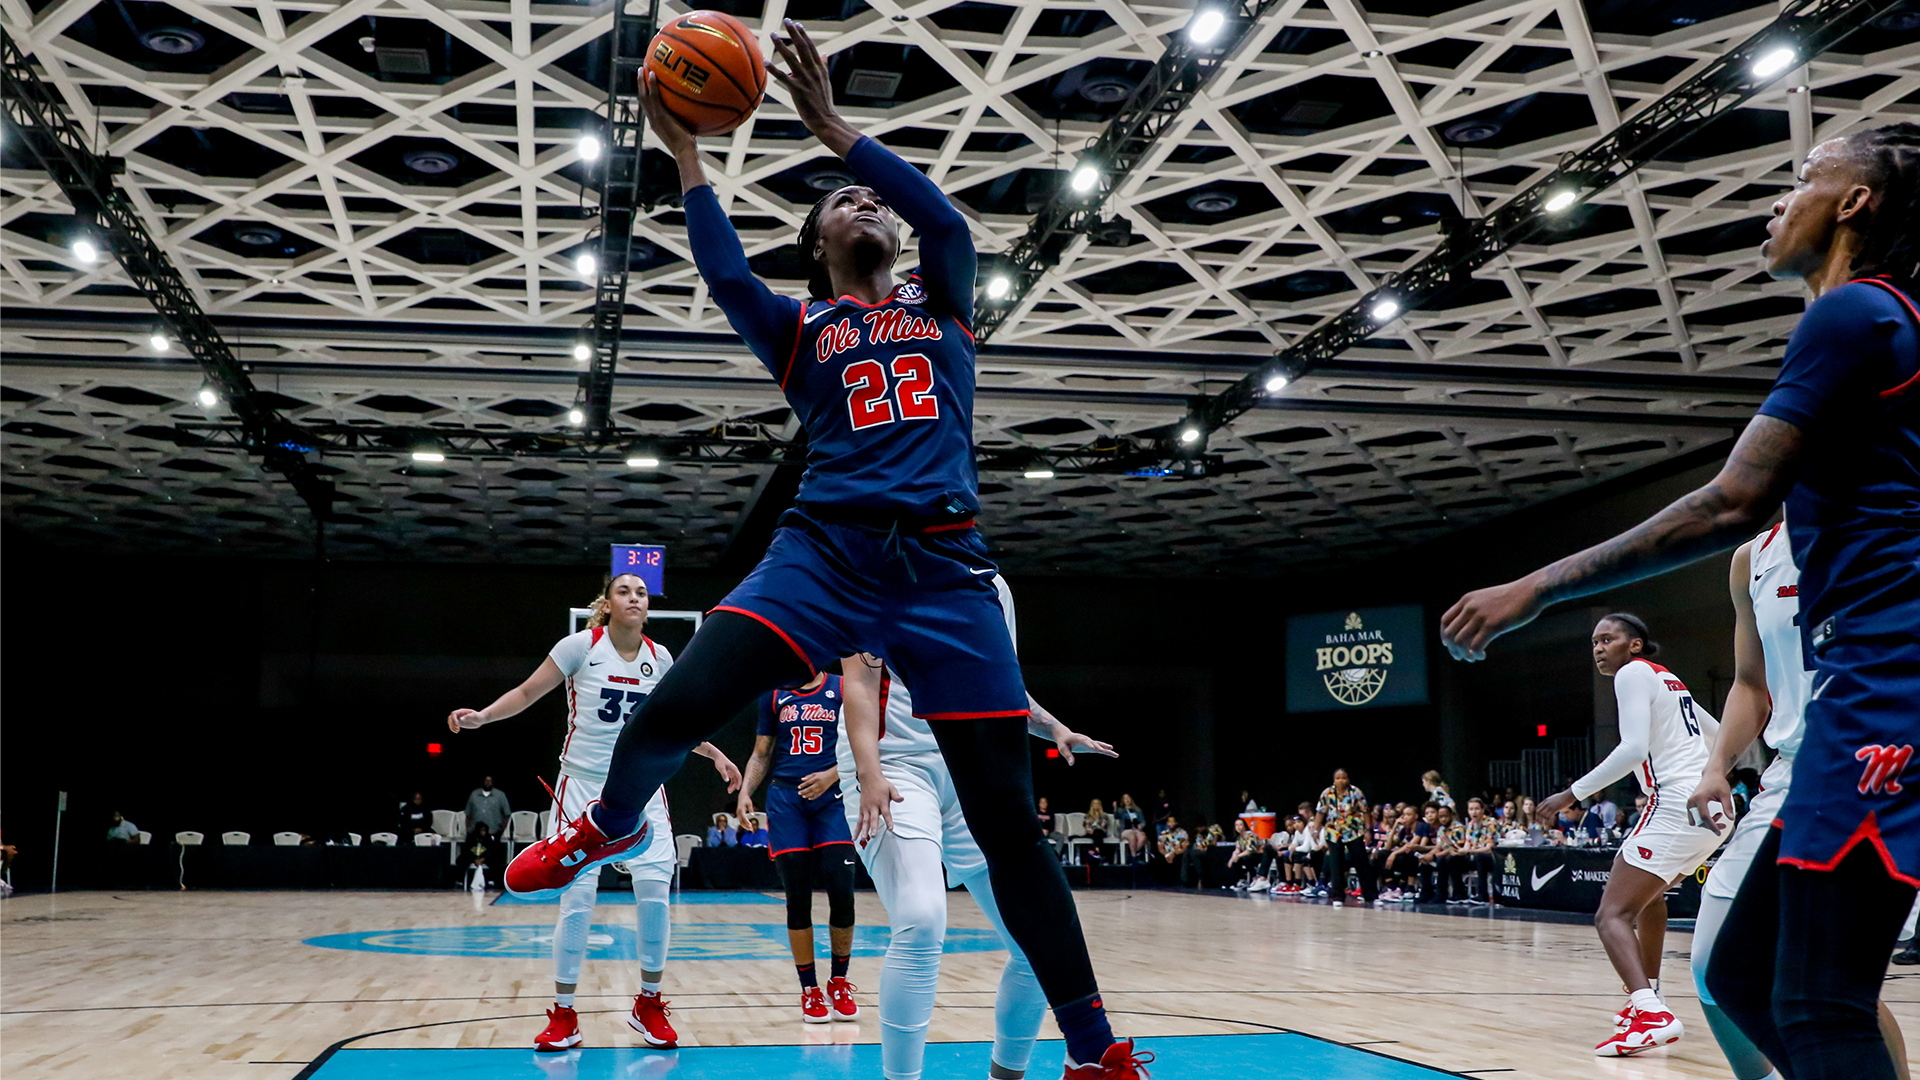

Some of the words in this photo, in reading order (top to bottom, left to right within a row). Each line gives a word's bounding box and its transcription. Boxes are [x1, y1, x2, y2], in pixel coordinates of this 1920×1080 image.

[653, 40, 711, 89] ELITE
[898, 283, 922, 299] SEC
[816, 317, 861, 364] Ole
[863, 307, 943, 346] Miss
[841, 352, 940, 432] 22
[628, 550, 661, 566] 3:12
[1325, 633, 1356, 644] BAHA
[1357, 629, 1385, 641] MAR
[1316, 642, 1394, 671] HOOPS
[780, 704, 799, 723] Ole
[801, 703, 836, 722] Miss
[1679, 696, 1700, 737] 13
[790, 726, 823, 755] 15
